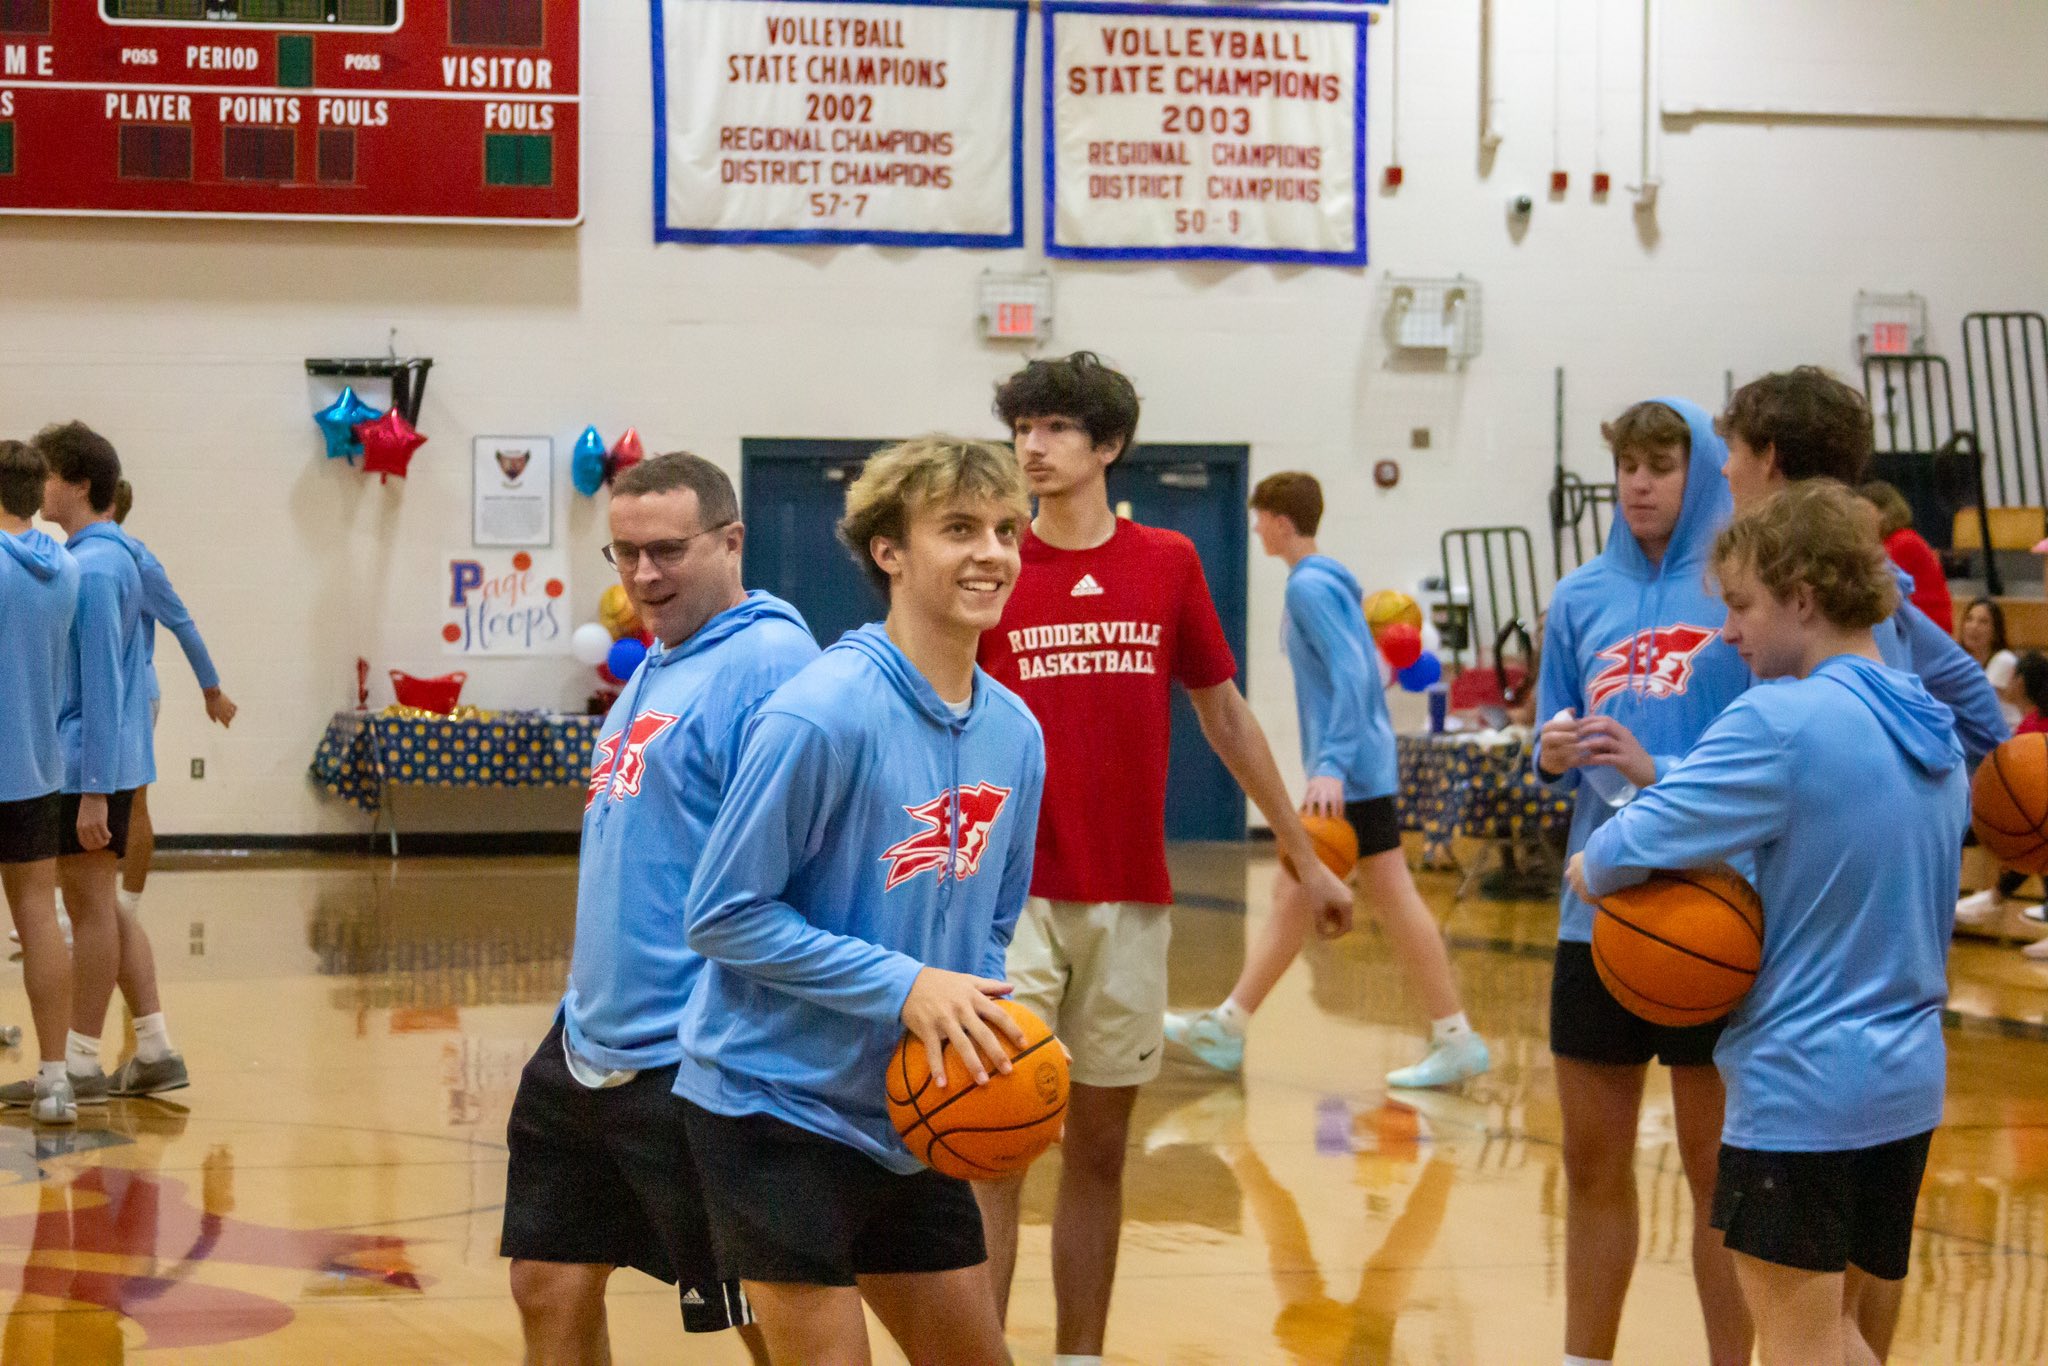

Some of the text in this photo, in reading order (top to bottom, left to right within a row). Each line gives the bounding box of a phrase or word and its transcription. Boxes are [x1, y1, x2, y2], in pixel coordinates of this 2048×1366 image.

[766, 16, 905, 49] VOLLEYBALL
[1101, 28, 1310, 62] VOLLEYBALL
[121, 48, 158, 65] POSS
[186, 45, 259, 70] PERIOD
[344, 53, 381, 71] POSS
[442, 56, 553, 89] VISITOR
[728, 55, 948, 89] STATE CHAMPIONS
[1068, 65, 1341, 103] STATE CHAMPIONS
[105, 93, 192, 121] PLAYER
[219, 96, 300, 124] POINTS
[318, 98, 388, 126] FOULS
[484, 102, 555, 130] FOULS
[806, 94, 873, 123] 2002
[1161, 105, 1251, 136] 2003
[720, 127, 953, 156] REGIONAL CHAMPIONS
[1088, 142, 1321, 171] REGIONAL CHAMPIONS
[720, 159, 953, 190] DISTRICT CHAMPIONS
[1088, 174, 1321, 203] DISTRICT CHAMPIONS
[809, 192, 870, 218] 57-7
[1007, 621, 1162, 653] RUDDERVILLE
[1017, 650, 1156, 681] BASKETBALL
